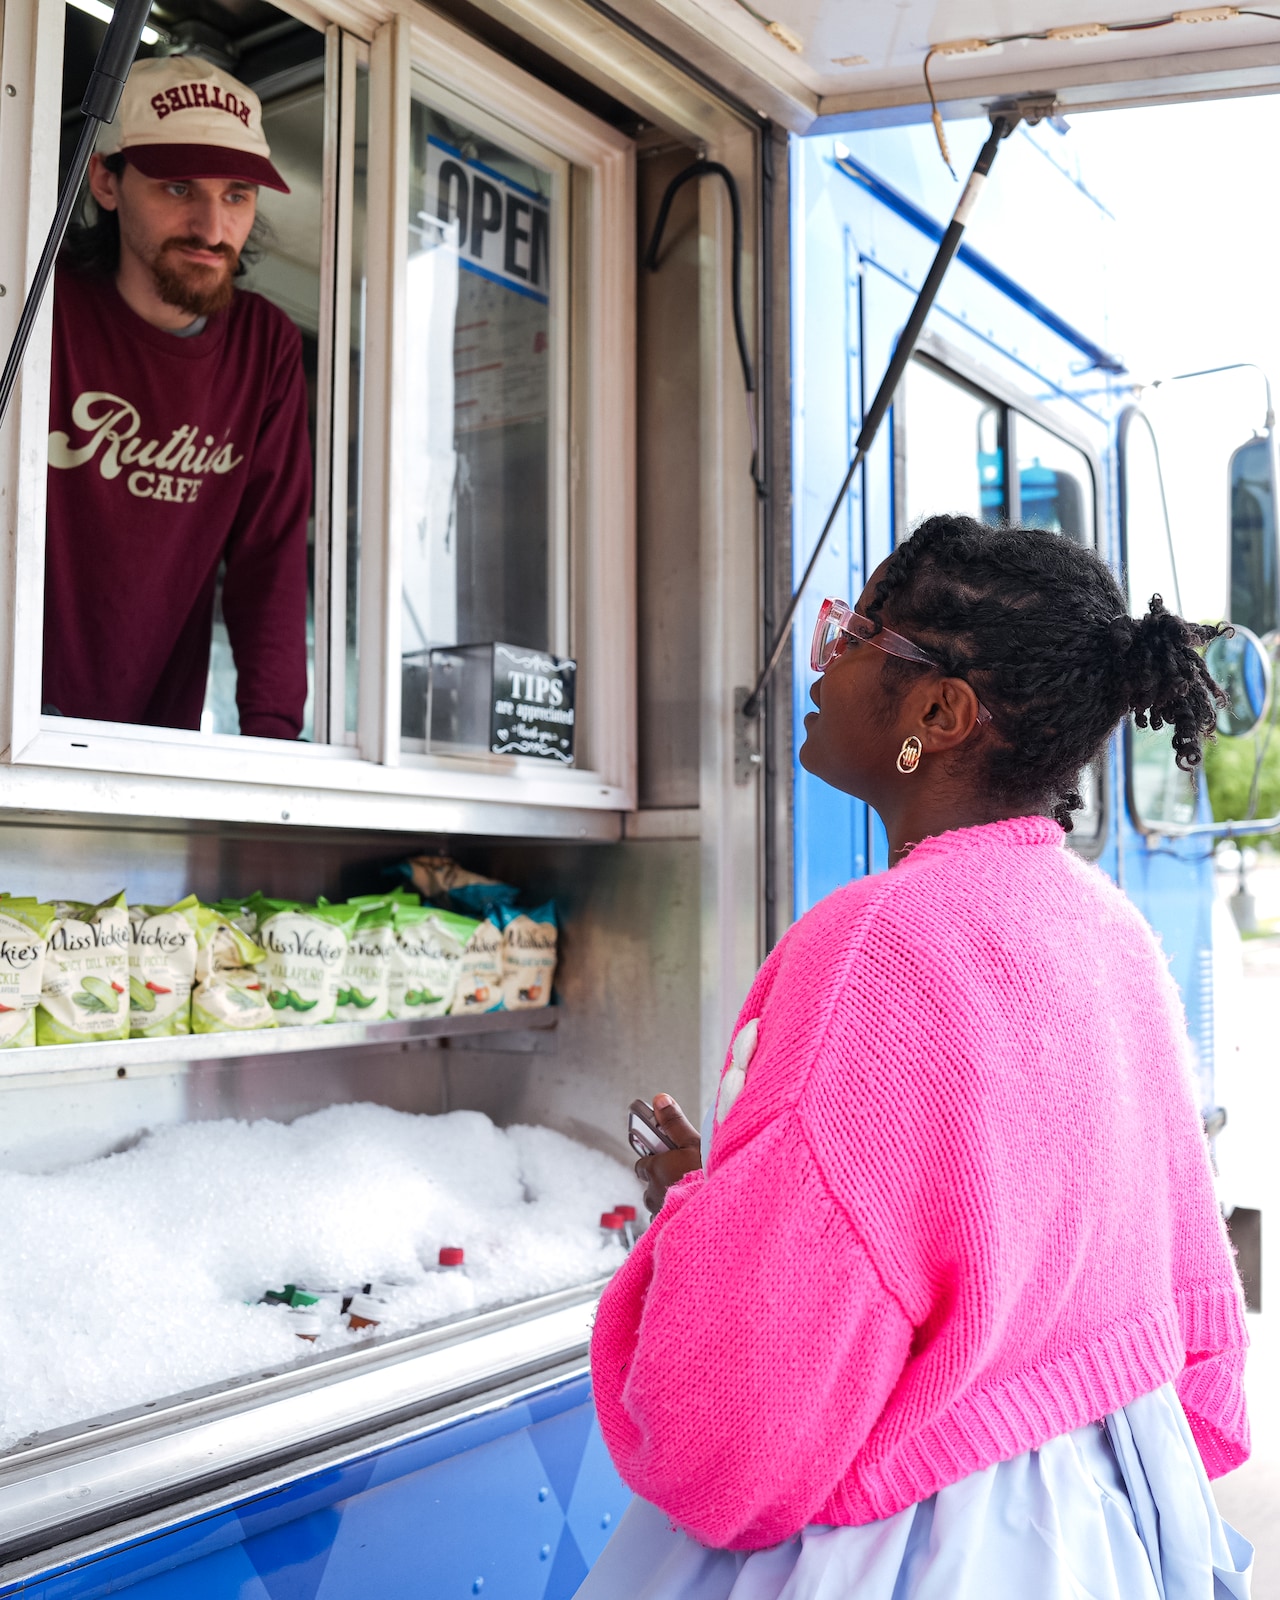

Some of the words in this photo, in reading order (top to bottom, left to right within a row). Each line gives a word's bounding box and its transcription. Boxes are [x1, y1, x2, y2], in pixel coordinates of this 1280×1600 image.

[150, 83, 251, 128] RUTHIES
[437, 160, 549, 285] OPEN
[507, 670, 563, 706] TIPS
[495, 700, 514, 716] are
[46, 927, 91, 952] Miss
[130, 917, 191, 954] Vickie's
